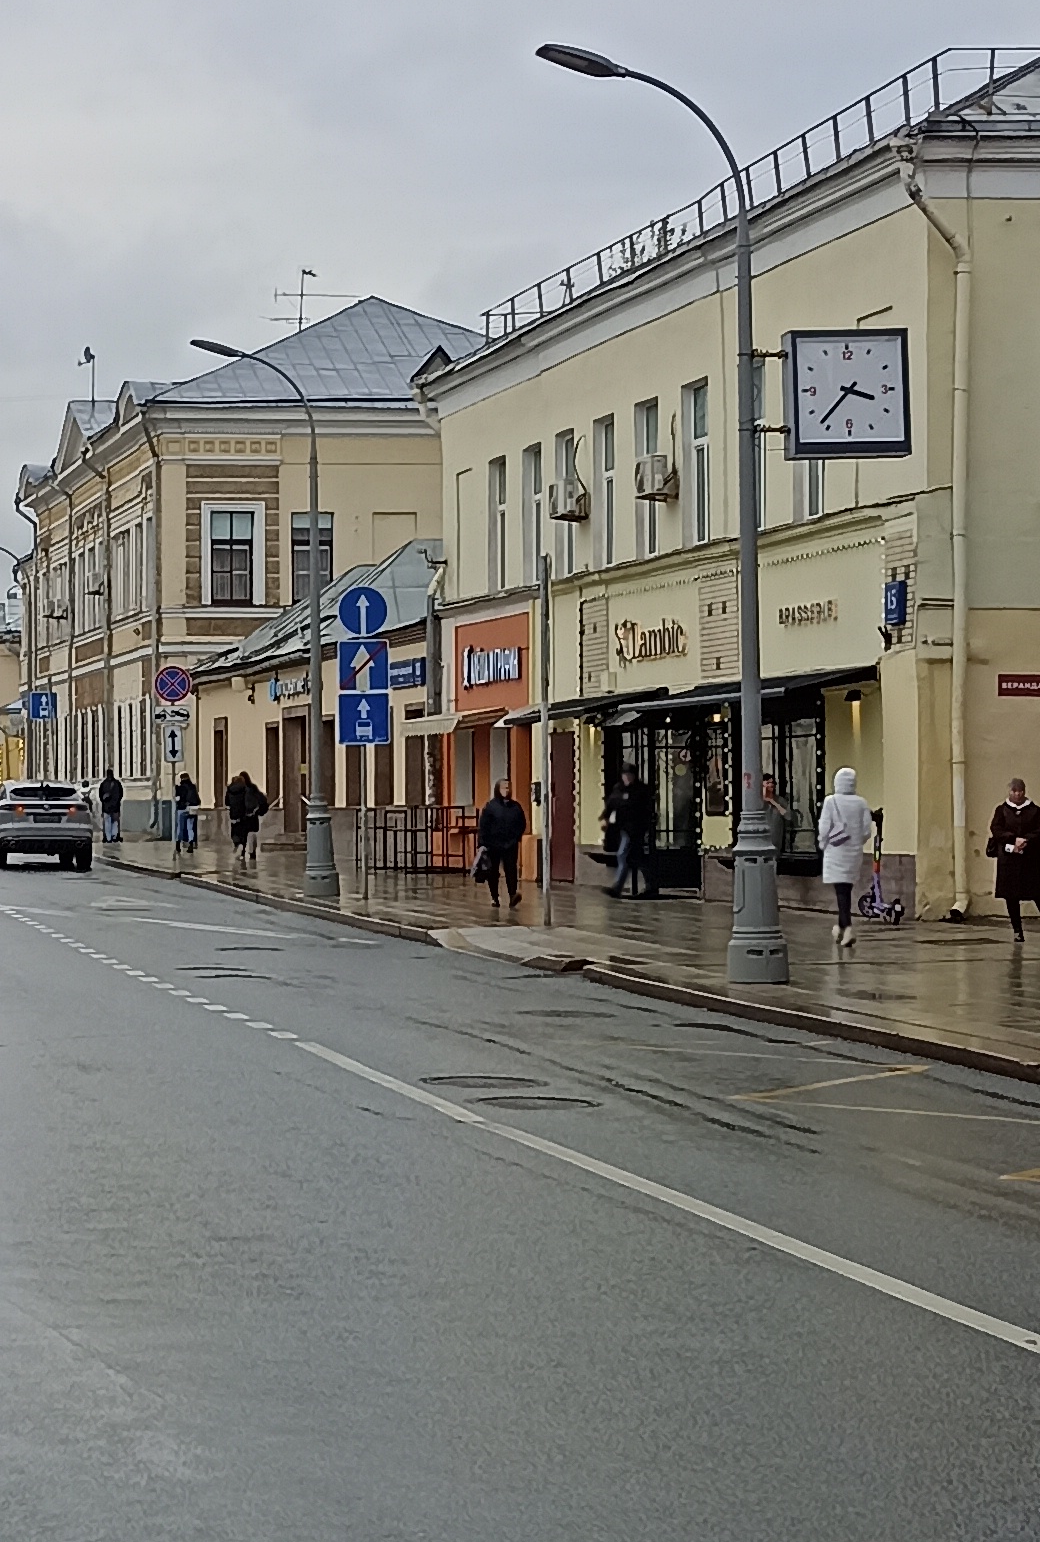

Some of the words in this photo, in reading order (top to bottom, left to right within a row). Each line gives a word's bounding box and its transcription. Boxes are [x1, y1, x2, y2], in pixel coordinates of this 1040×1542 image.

[842, 350, 853, 360] 12
[809, 386, 816, 396] 9
[881, 384, 888, 394] 3
[845, 419, 853, 429] 6
